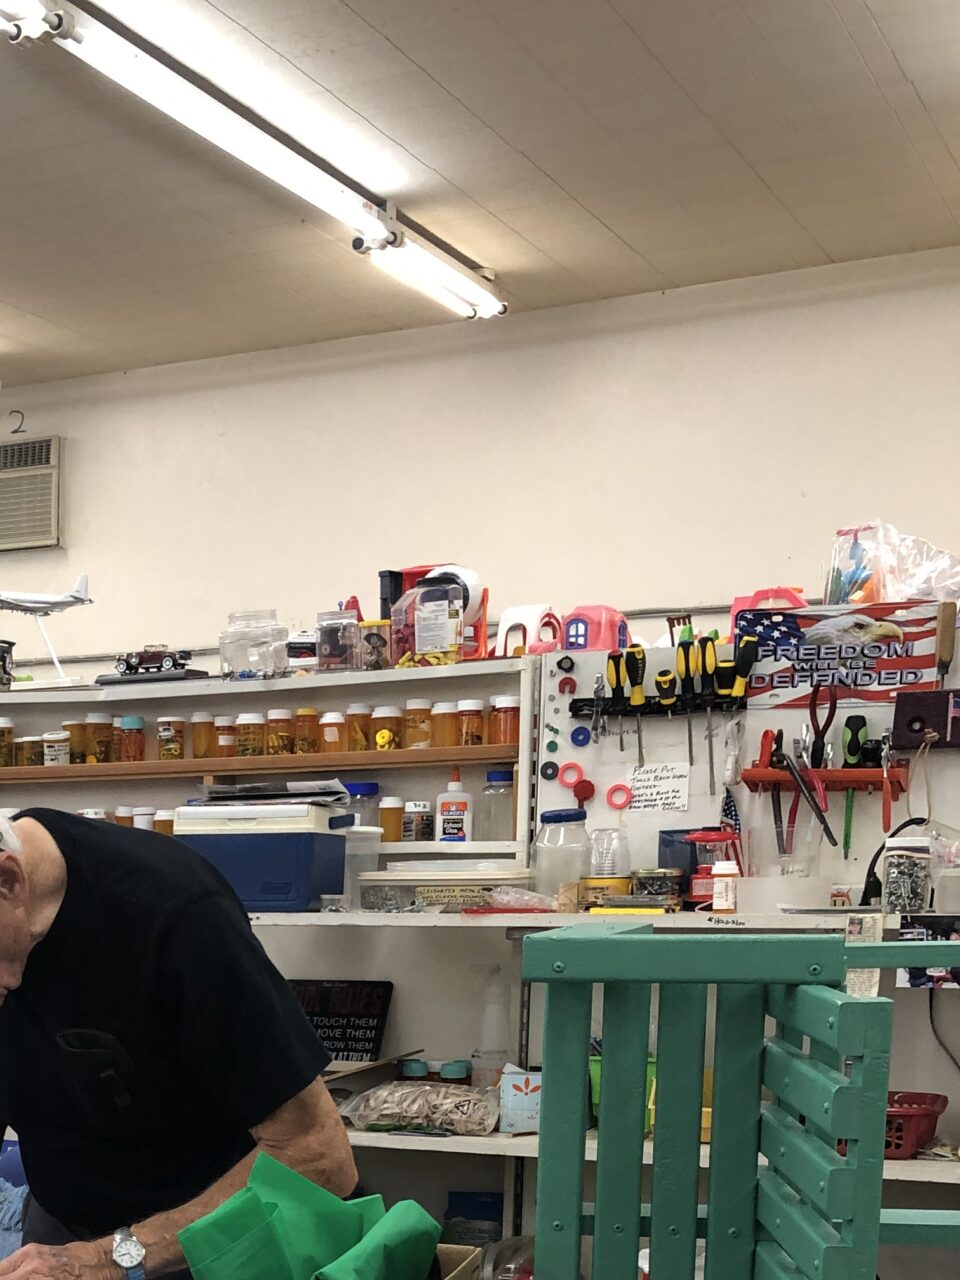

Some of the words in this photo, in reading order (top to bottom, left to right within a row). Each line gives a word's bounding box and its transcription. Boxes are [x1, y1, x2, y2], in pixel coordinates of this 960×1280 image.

[756, 641, 915, 662] FREEDOM
[793, 661, 839, 671] WILL
[849, 659, 877, 669] BE
[313, 1017, 347, 1026] TOUCH
[349, 1017, 378, 1027] THEM
[346, 1029, 375, 1038] THEM
[348, 1041, 373, 1049] THEM
